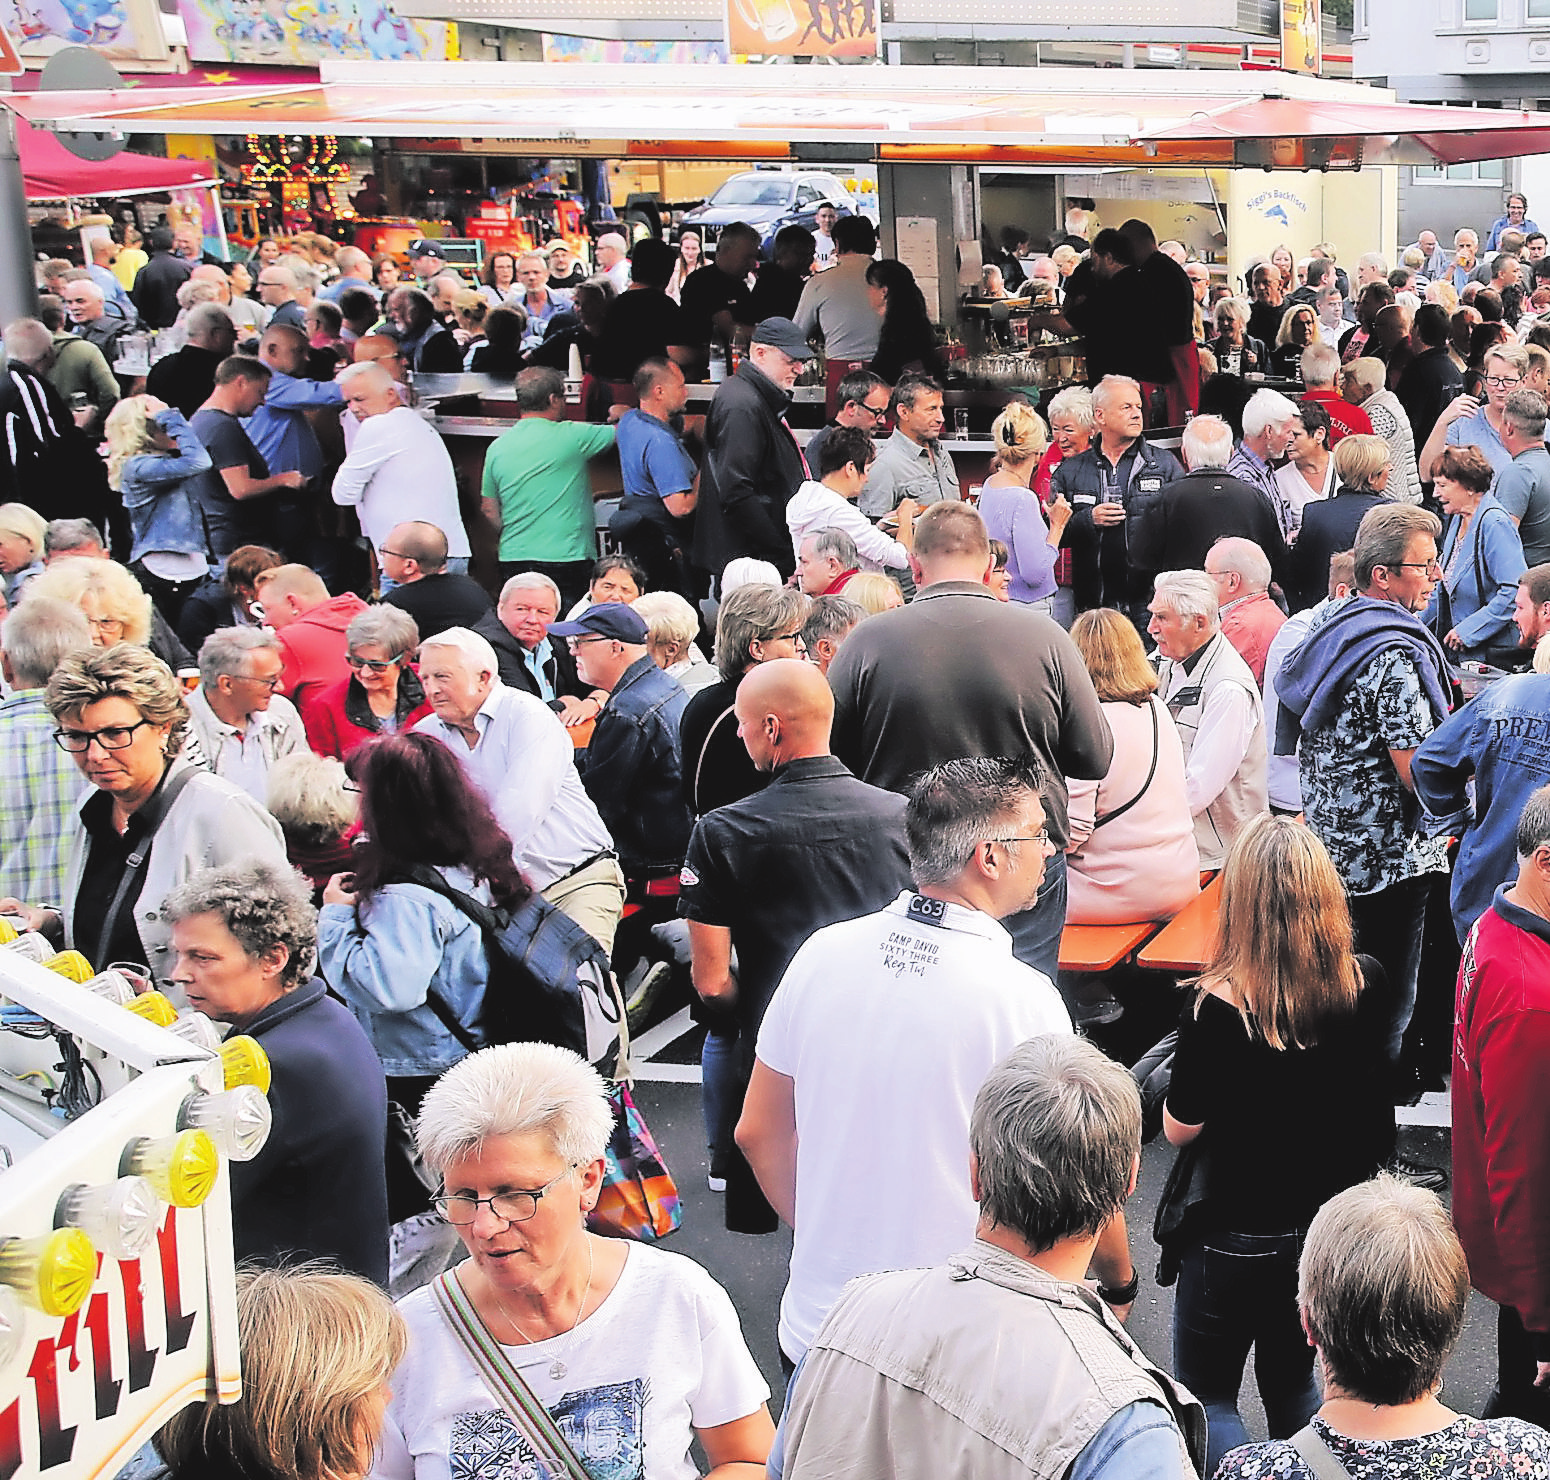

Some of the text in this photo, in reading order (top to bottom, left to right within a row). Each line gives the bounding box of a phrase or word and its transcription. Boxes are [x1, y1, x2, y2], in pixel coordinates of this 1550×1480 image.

[1246, 189, 1308, 212] Siggi's Backfisch
[910, 896, 944, 917] C63
[880, 943, 940, 965] SIXTY THREE
[888, 932, 940, 955] CAMP DAVID
